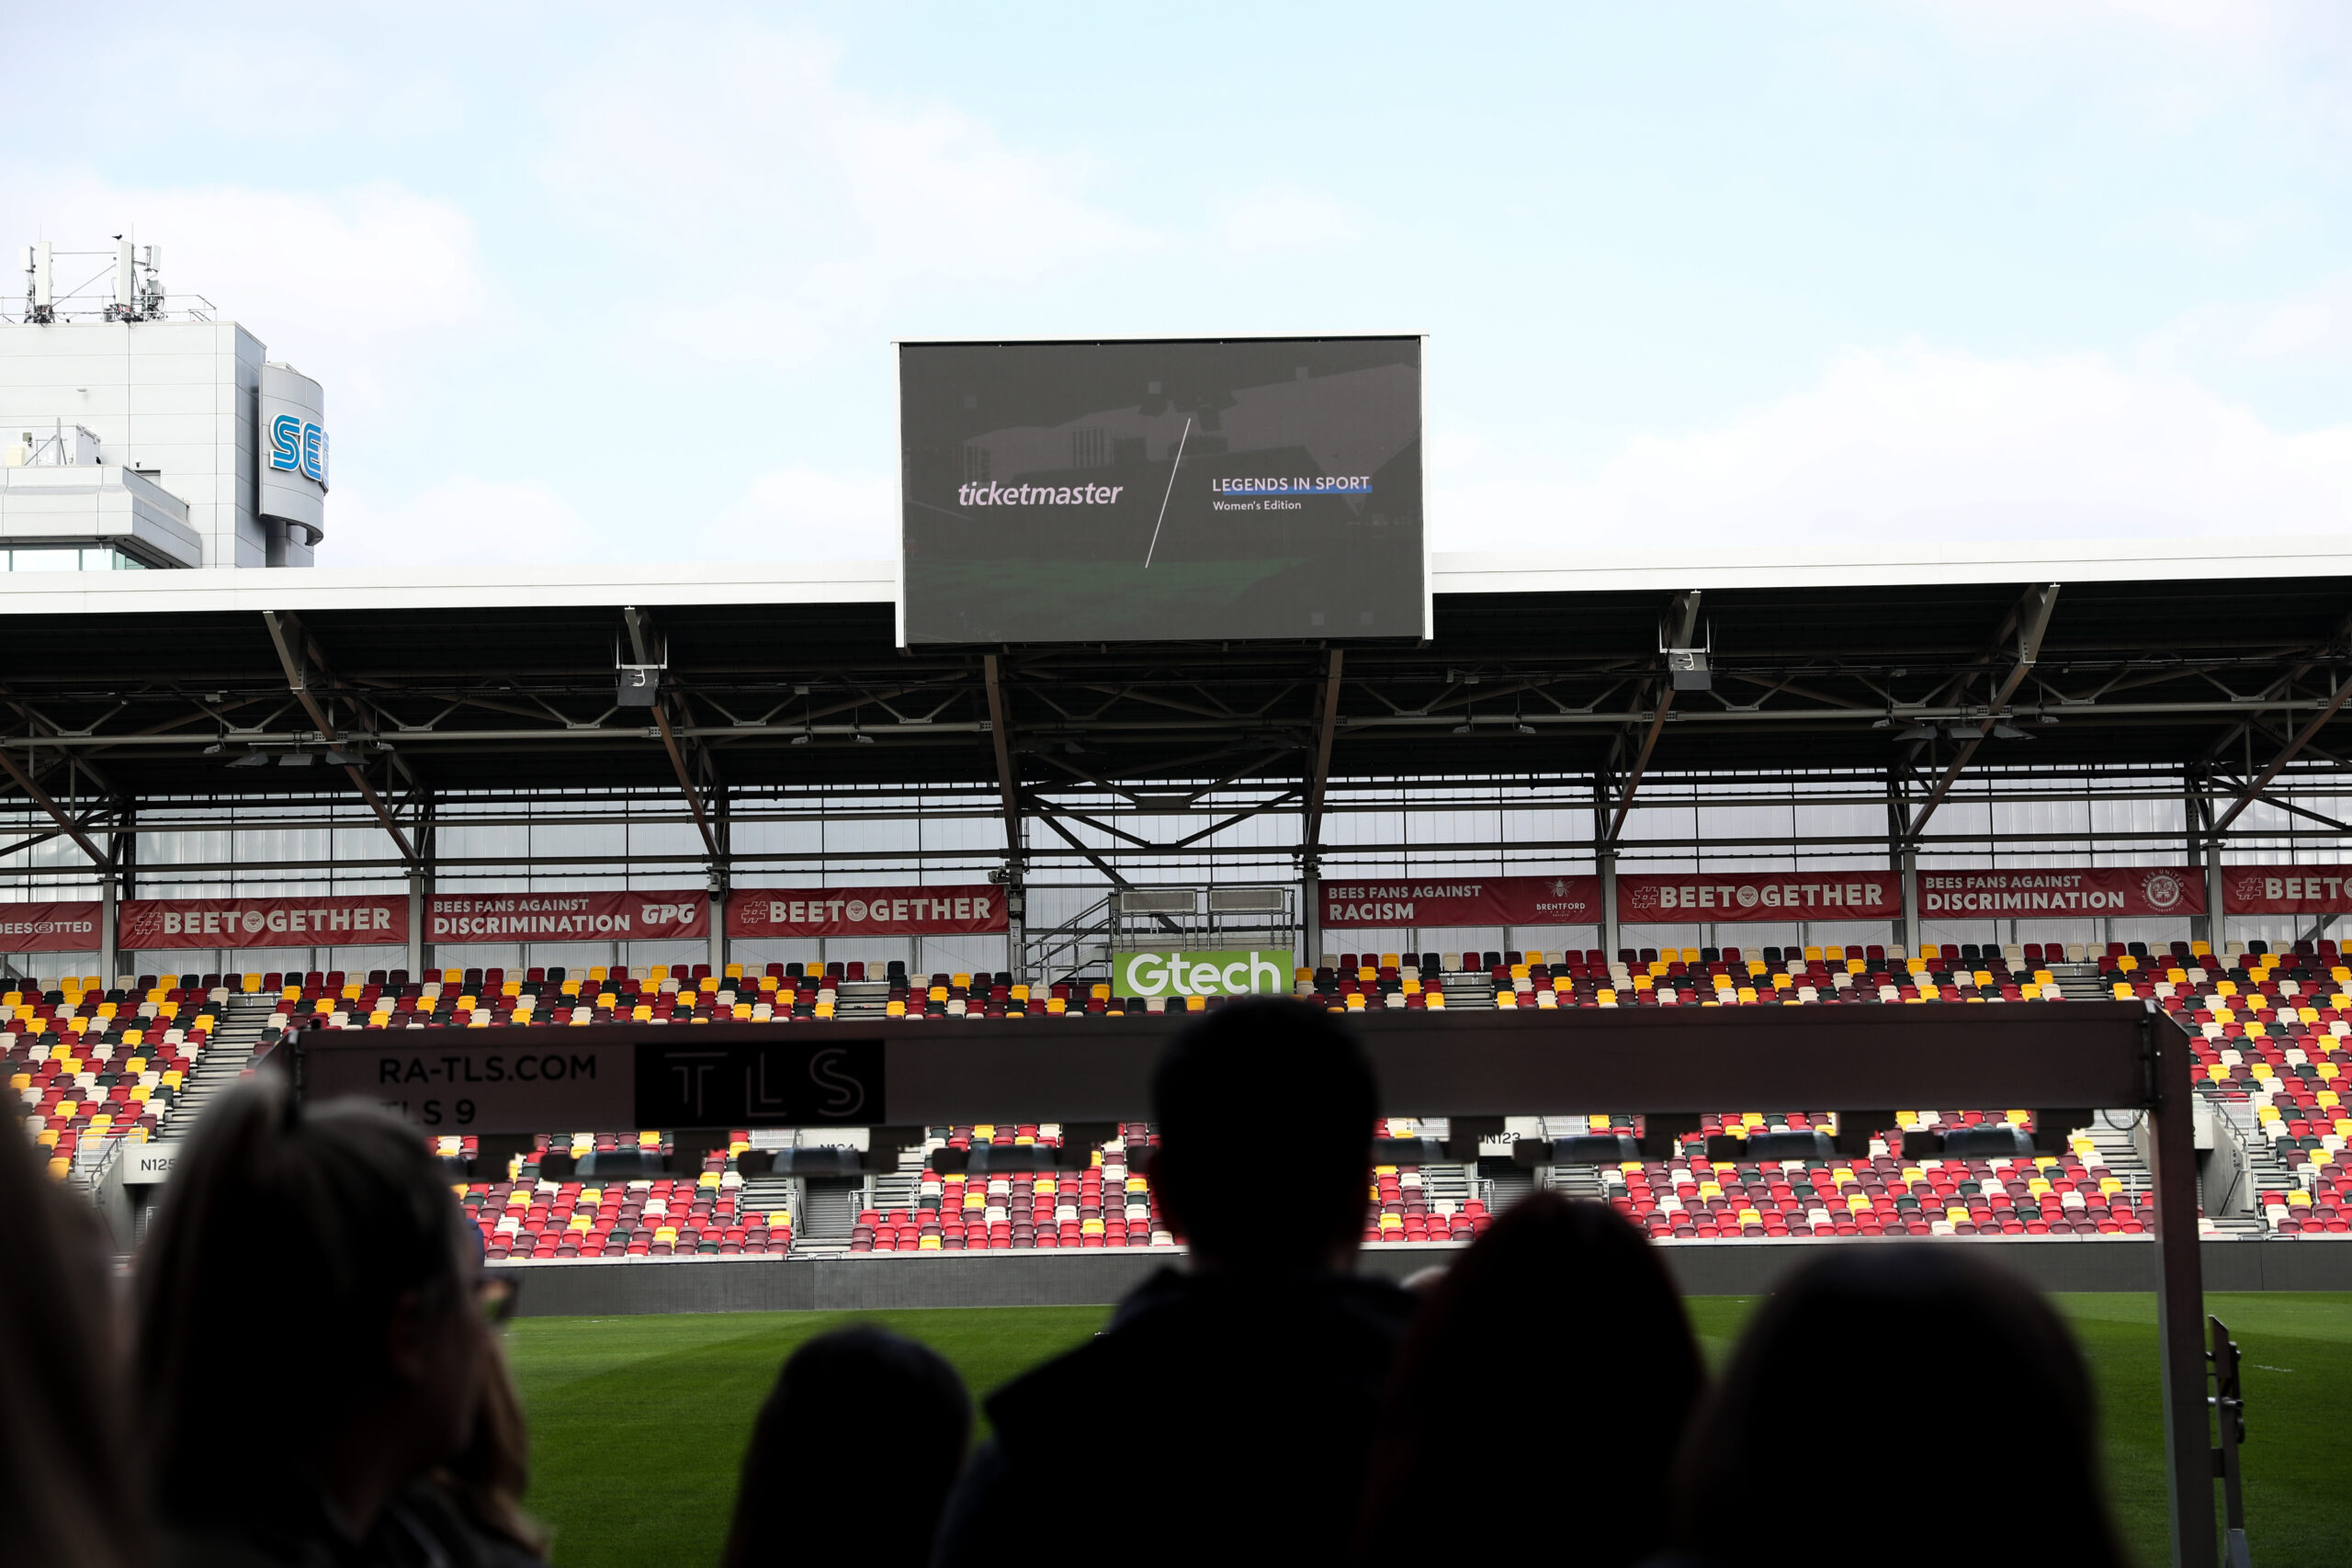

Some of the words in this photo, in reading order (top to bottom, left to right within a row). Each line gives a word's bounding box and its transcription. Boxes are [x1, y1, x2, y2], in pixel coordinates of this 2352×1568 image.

[1212, 478, 1288, 491] LEGENDS
[1294, 477, 1311, 491] IN
[1316, 476, 1370, 491] SPORT
[957, 480, 1124, 506] ticketmaster
[1213, 501, 1261, 511] Women's
[1264, 500, 1302, 511] Edition
[1926, 877, 1962, 889] BEES
[1966, 876, 2007, 888] FANS
[2010, 874, 2082, 887] AGAINST
[1329, 887, 1365, 899] BEES
[1369, 886, 1408, 898] FANS
[1412, 885, 1482, 897] AGAINST
[1926, 891, 2124, 910] DISCRIMINATION
[434, 901, 471, 913] BEES
[475, 900, 514, 912] FANS
[518, 898, 590, 911] AGAINST
[641, 903, 695, 924] GPG
[1329, 902, 1414, 920] RACISM
[1536, 902, 1586, 910] BRENTFORD
[434, 914, 630, 934] DISCRIMINATION
[1126, 951, 1282, 996] Gtech
[379, 1055, 596, 1083] RA-TLS.COM
[456, 1099, 476, 1125] 9
